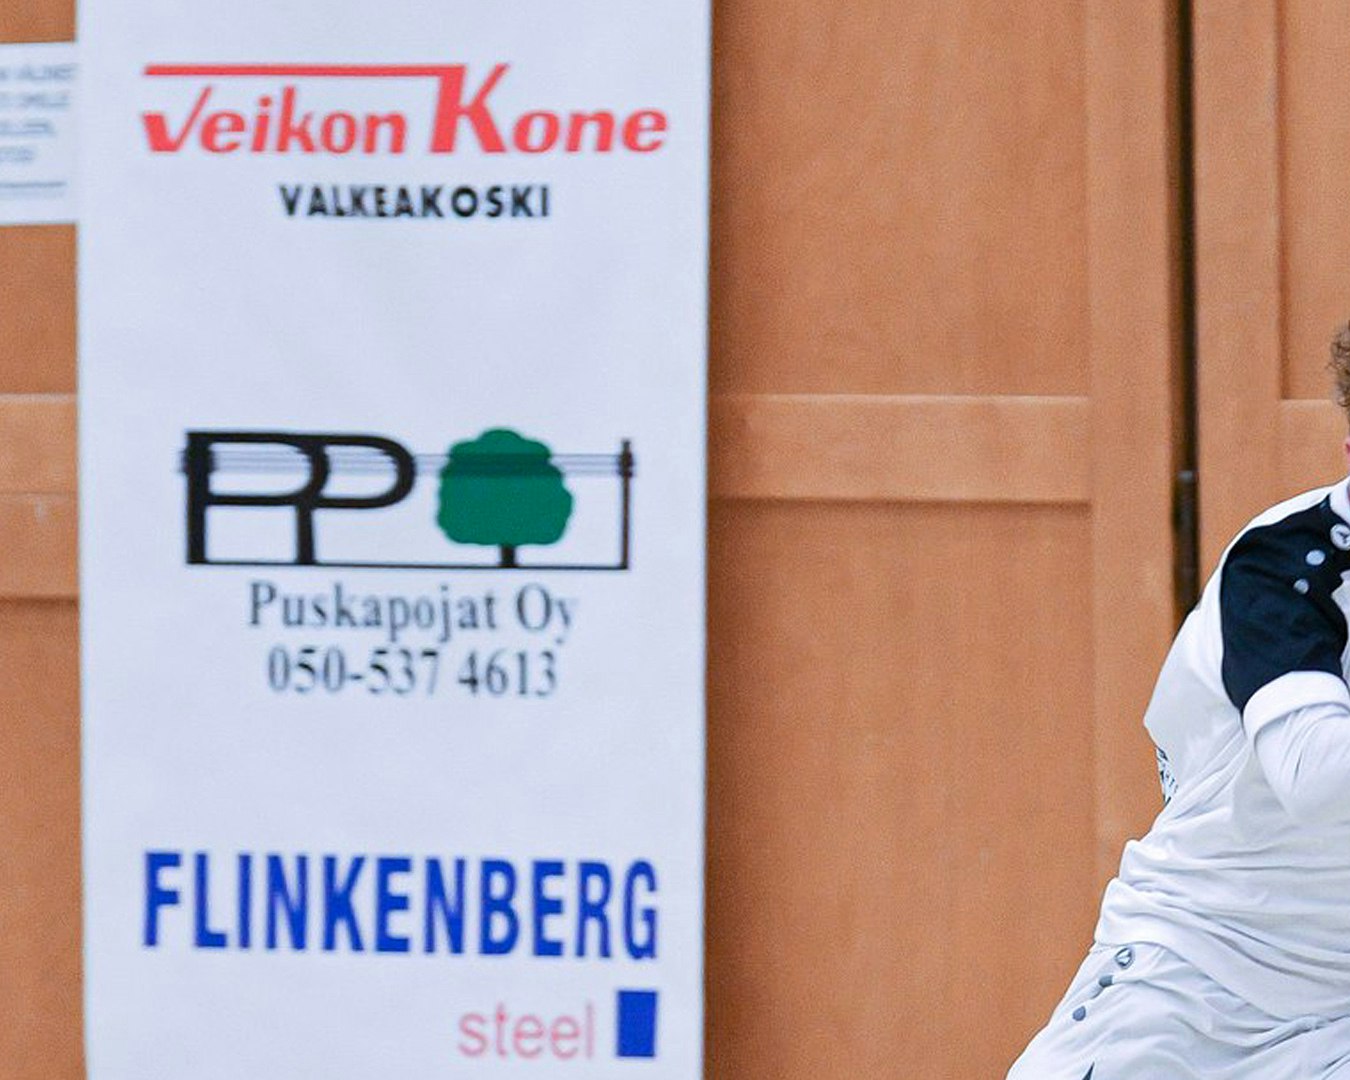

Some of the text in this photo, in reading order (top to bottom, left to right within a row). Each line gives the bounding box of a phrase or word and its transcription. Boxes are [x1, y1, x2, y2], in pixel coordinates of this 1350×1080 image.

[141, 63, 669, 155] Veikon Kone
[279, 185, 551, 219] VALKEAKOSKI
[247, 580, 574, 645] Puskapojat Oy
[266, 645, 559, 698] 050-537 4613
[143, 851, 659, 961] FLINKENBERG
[458, 1003, 596, 1061] steel
